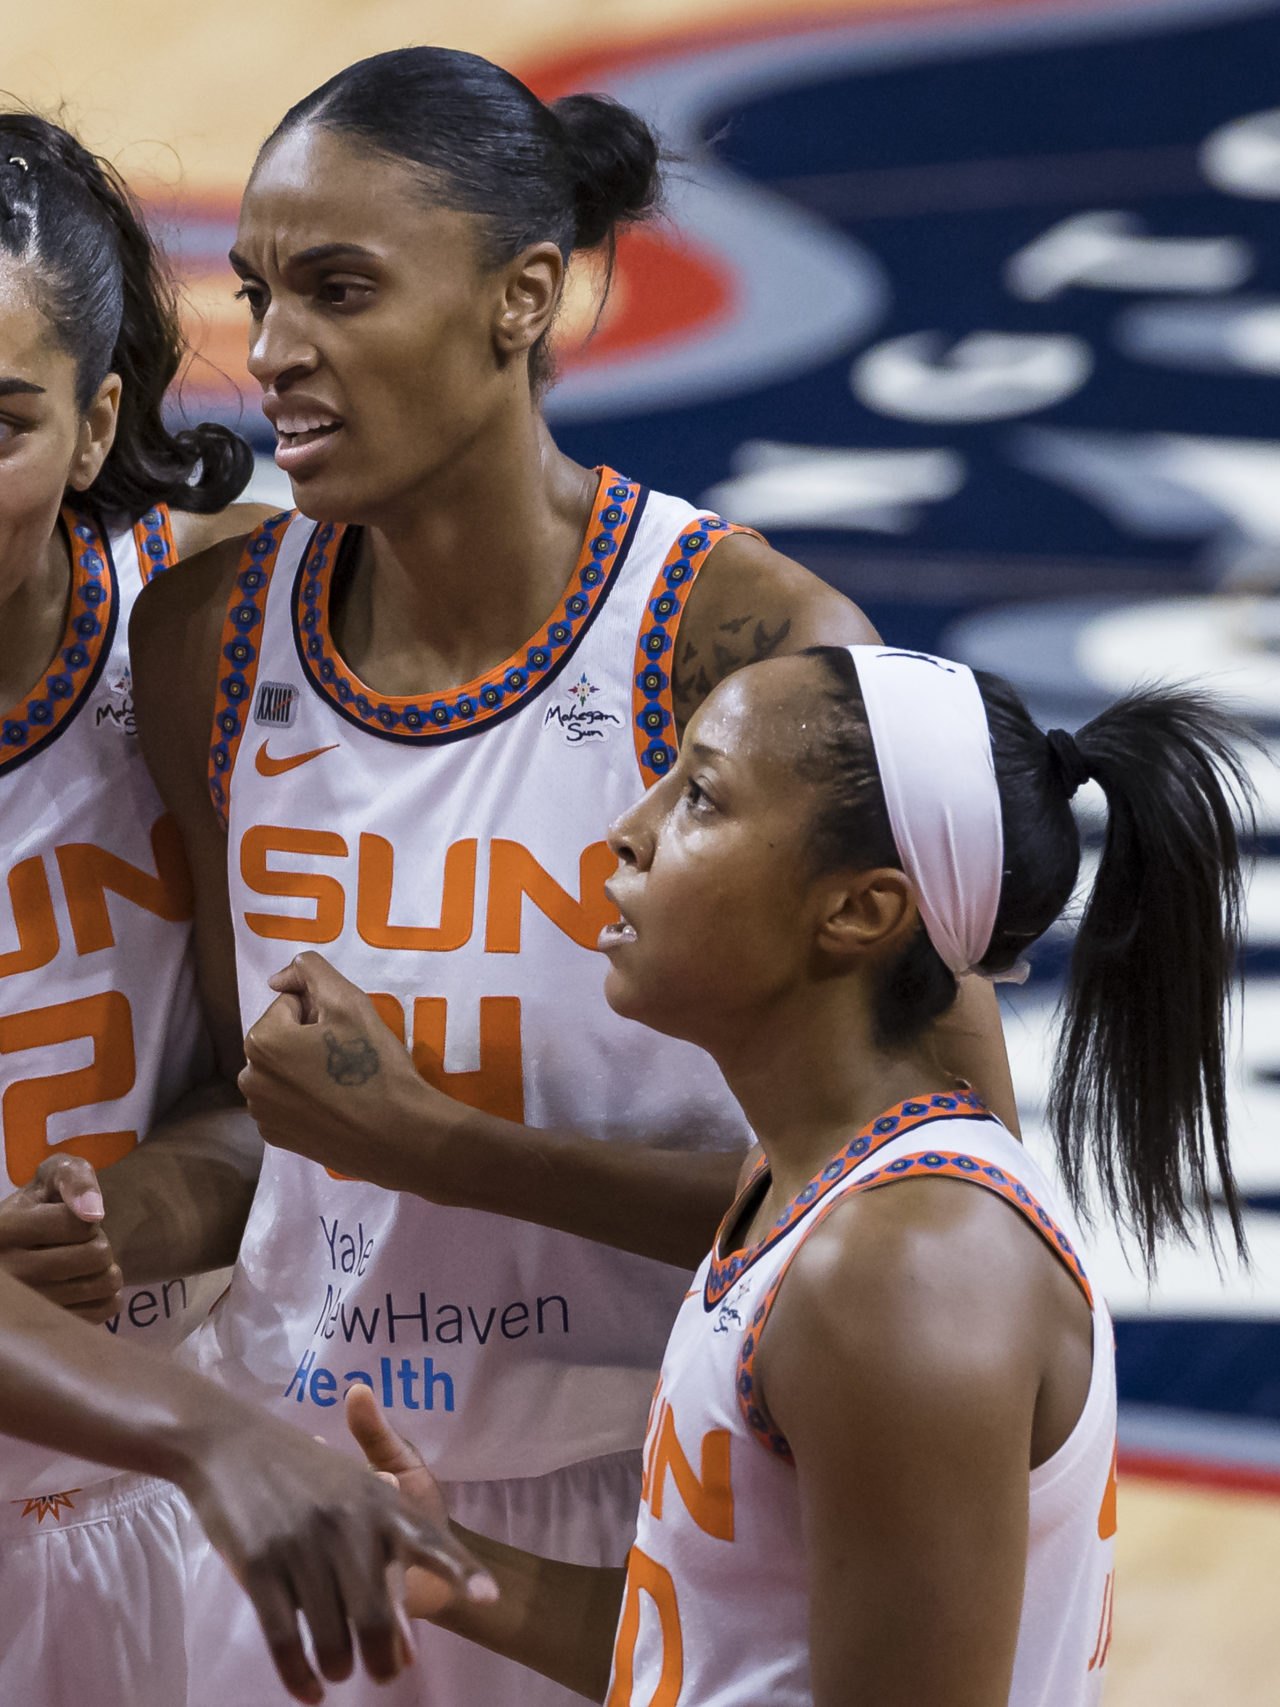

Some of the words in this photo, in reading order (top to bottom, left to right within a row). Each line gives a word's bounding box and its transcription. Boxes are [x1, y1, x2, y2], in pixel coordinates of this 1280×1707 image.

[544, 704, 620, 727] Mohegan
[566, 722, 604, 742] Sun
[239, 825, 620, 954] SUN
[320, 1216, 373, 1276] Yale
[314, 1284, 569, 1344] NewHaven
